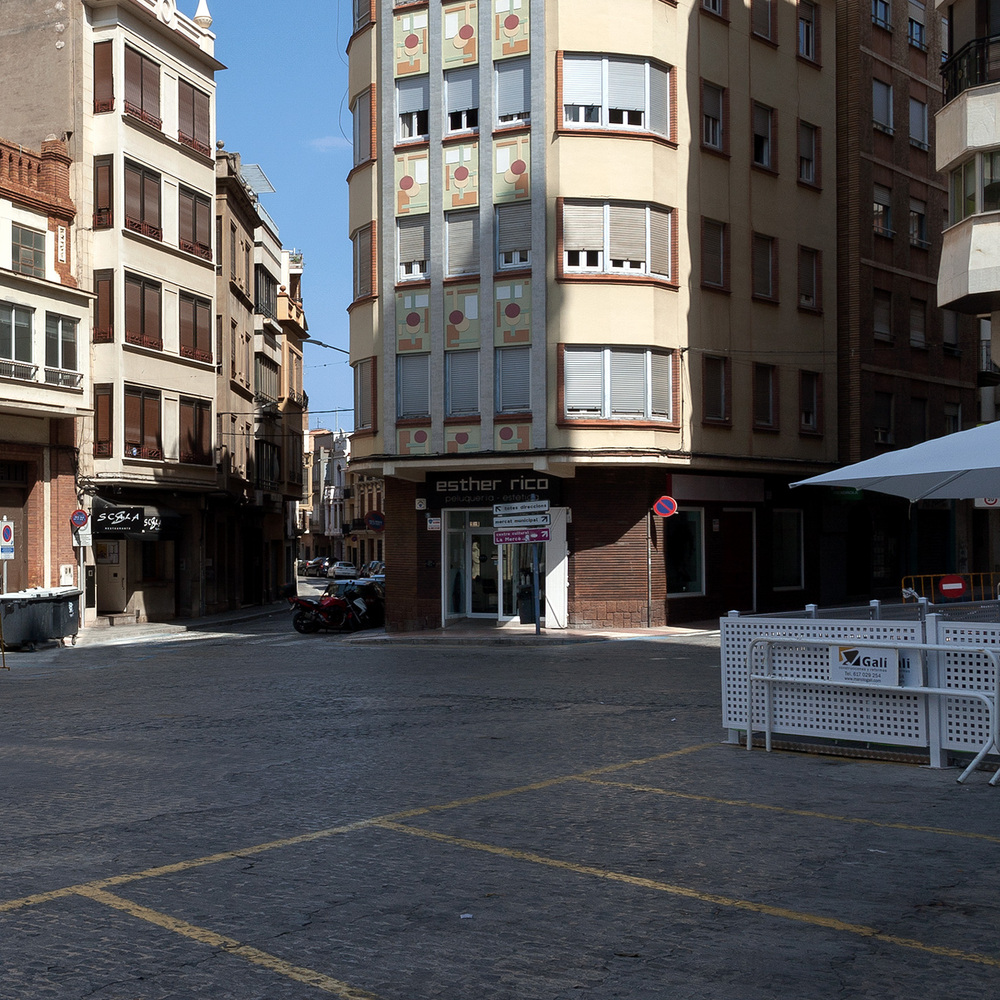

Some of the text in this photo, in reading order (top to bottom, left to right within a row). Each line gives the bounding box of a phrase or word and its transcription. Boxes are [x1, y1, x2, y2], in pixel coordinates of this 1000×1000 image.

[436, 475, 549, 492] esther rico
[97, 510, 140, 525] SCALA
